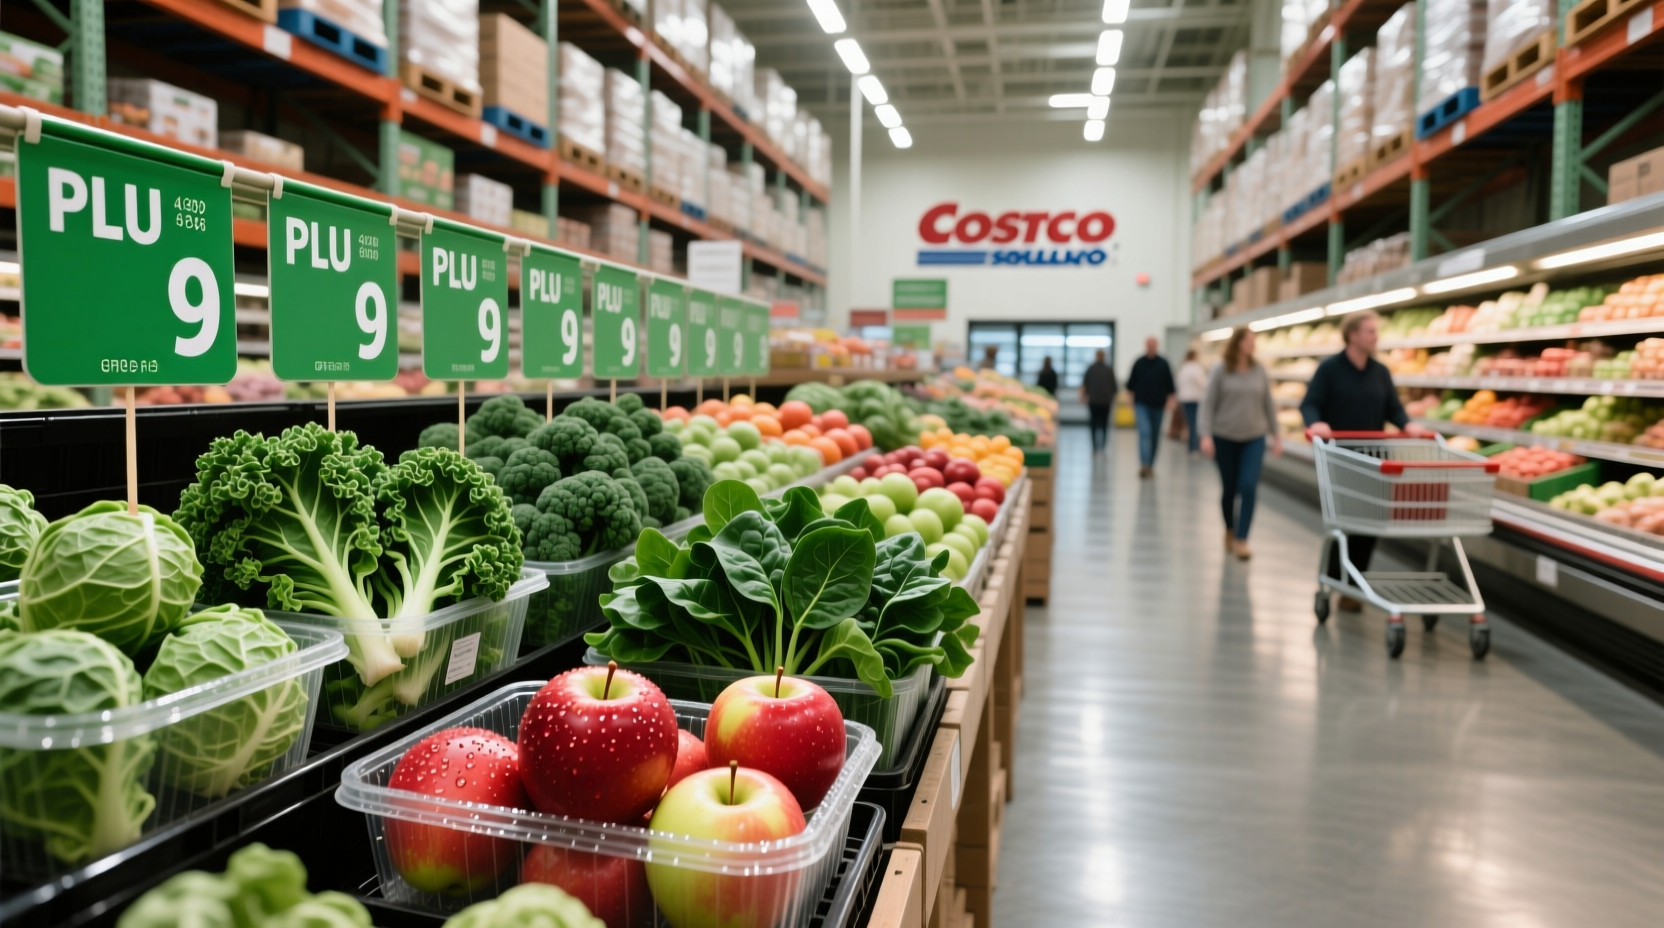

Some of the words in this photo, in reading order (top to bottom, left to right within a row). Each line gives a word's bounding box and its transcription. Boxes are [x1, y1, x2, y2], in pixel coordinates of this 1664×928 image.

[48, 167, 161, 245] PLU
[286, 216, 351, 272] PLU
[433, 247, 477, 291] PLU
[168, 257, 220, 357] 9
[530, 268, 561, 304] PLU
[597, 282, 622, 313] PLU
[355, 282, 387, 359] 9
[478, 298, 501, 363] 9
[561, 309, 578, 365] 9
[621, 318, 636, 366] 9
[669, 324, 681, 367] 9
